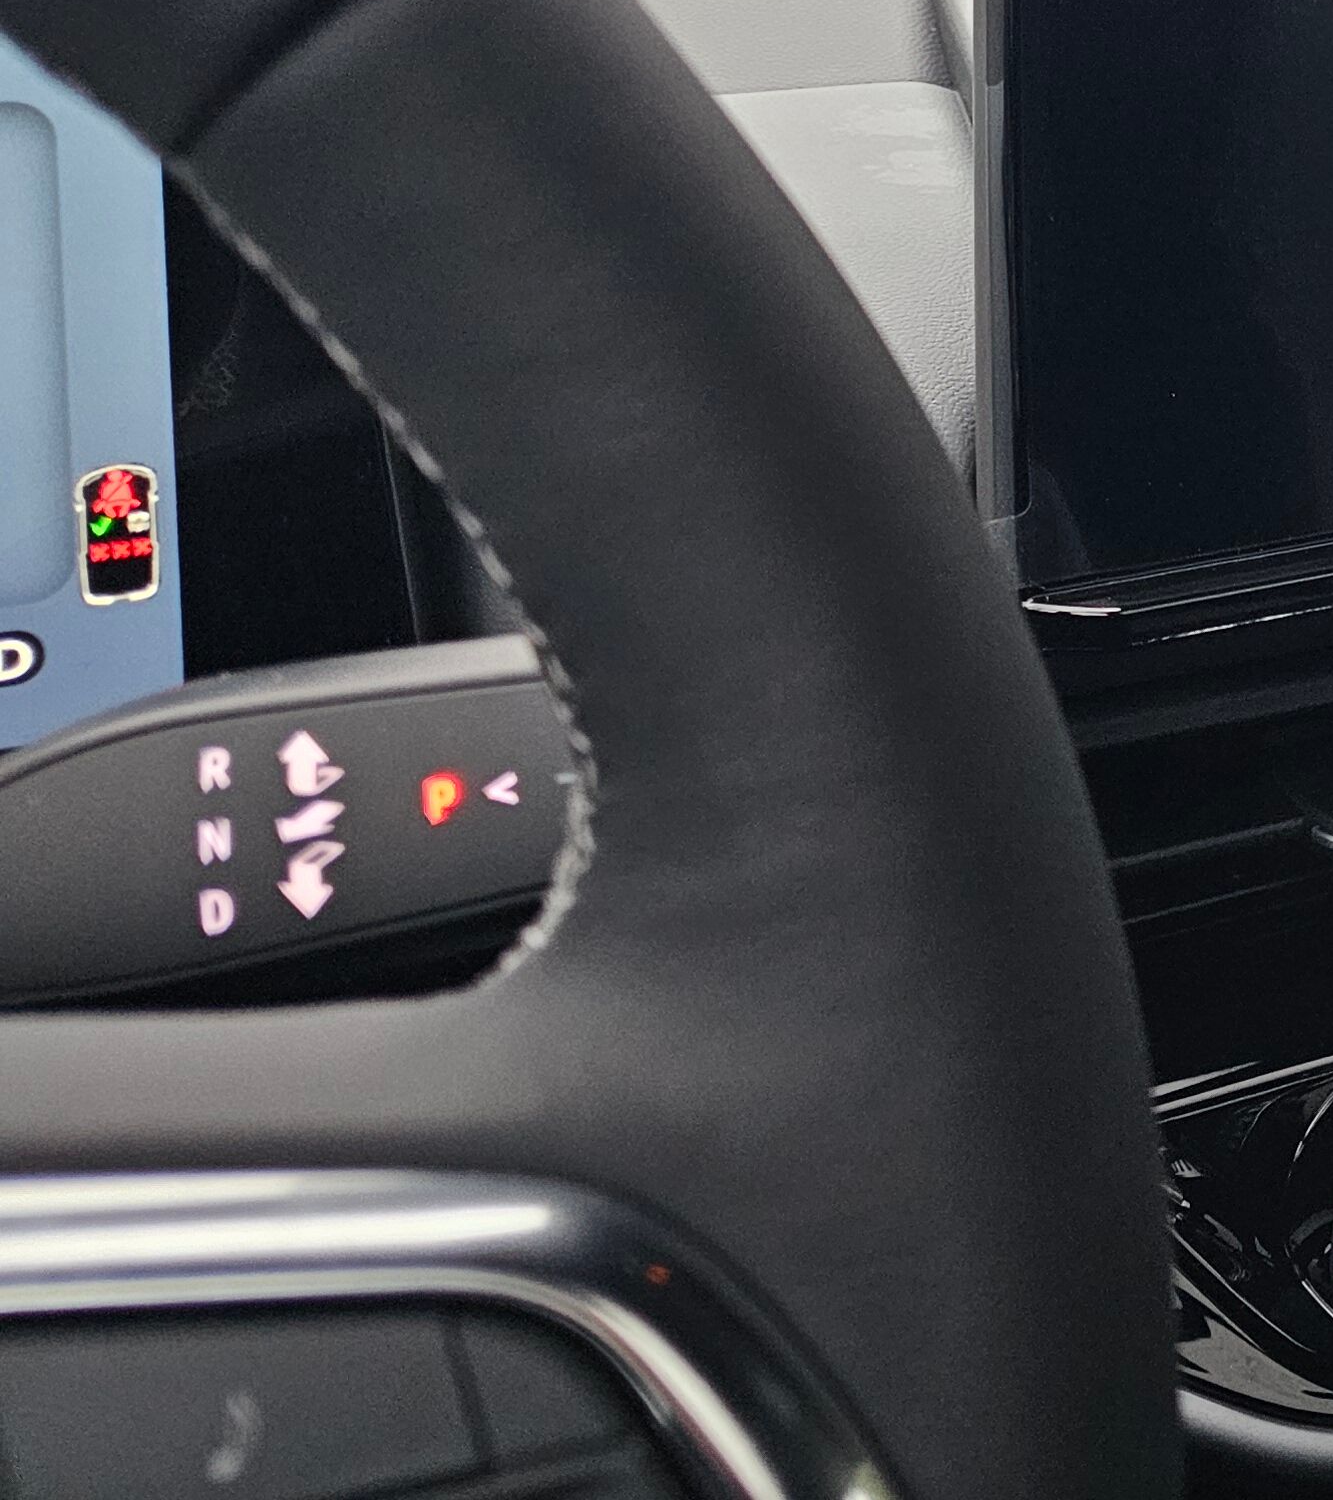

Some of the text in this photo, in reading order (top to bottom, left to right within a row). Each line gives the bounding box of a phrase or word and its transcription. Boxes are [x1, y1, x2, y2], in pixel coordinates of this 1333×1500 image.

[0, 640, 33, 681] D
[200, 746, 233, 793] R
[422, 772, 463, 826] P
[198, 817, 233, 865] N
[200, 889, 235, 936] D
